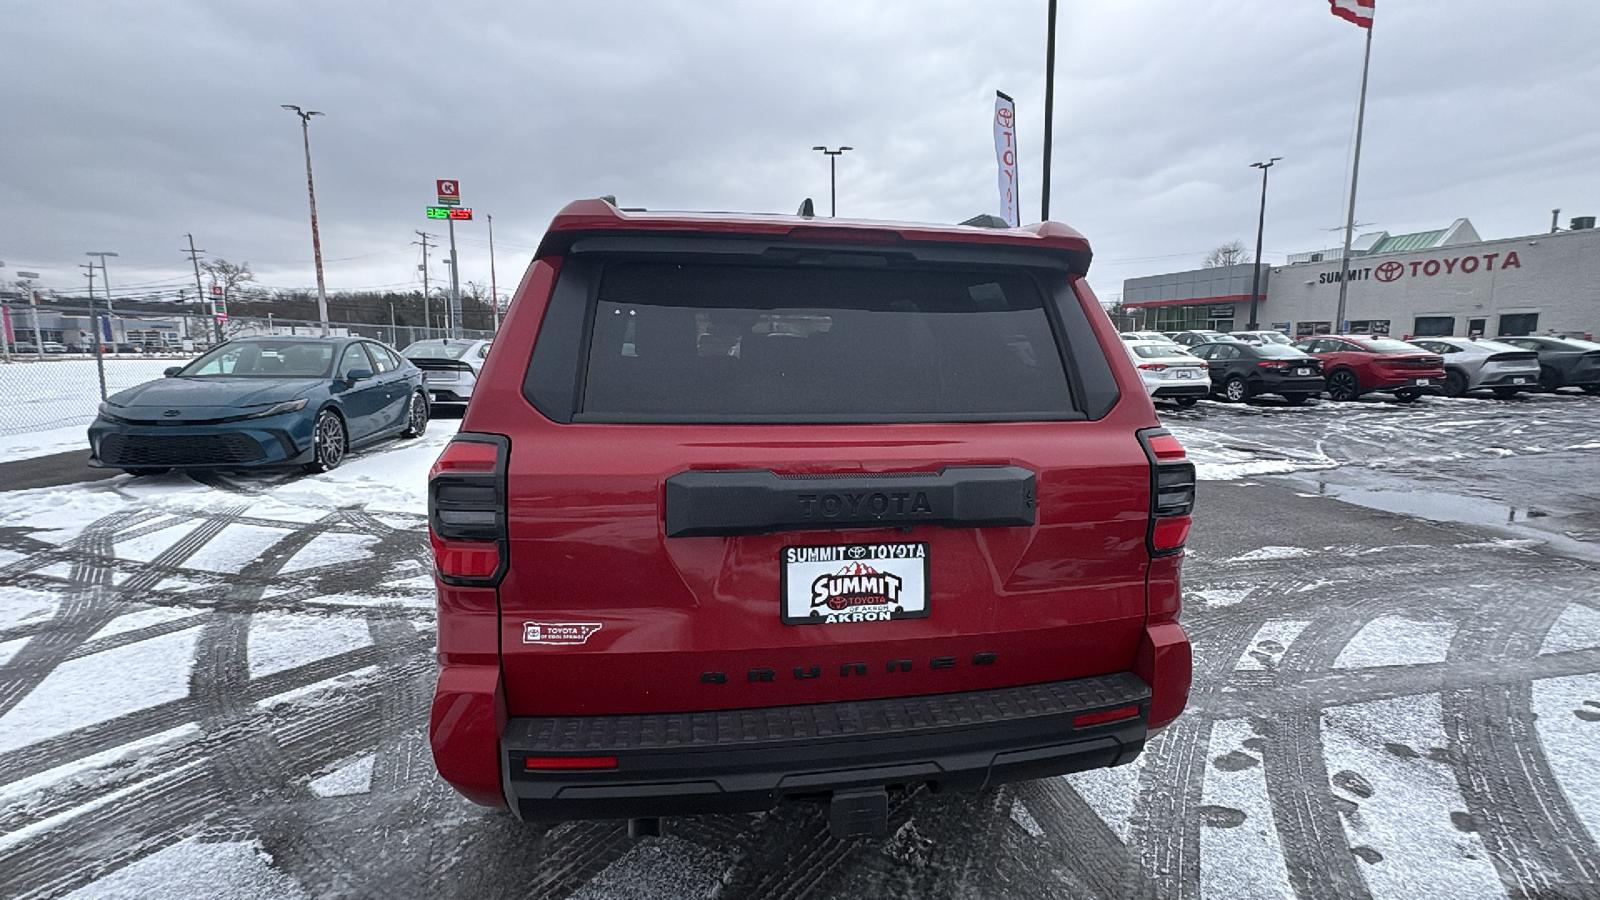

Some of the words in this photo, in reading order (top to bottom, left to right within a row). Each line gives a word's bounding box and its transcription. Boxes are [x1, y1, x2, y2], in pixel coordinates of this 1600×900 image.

[1003, 131, 1014, 222] TOYOT
[1319, 267, 1372, 284] SUMMIT
[1409, 251, 1521, 277] TOYOTA
[798, 491, 932, 518] TOYOTA
[787, 546, 846, 563] SUMMIT
[869, 544, 926, 559] TOYOTA
[813, 573, 901, 605] SUMMIT
[848, 596, 886, 605] TOYOTA
[825, 611, 891, 624] AKRON
[700, 652, 997, 684] 4RUNNER
